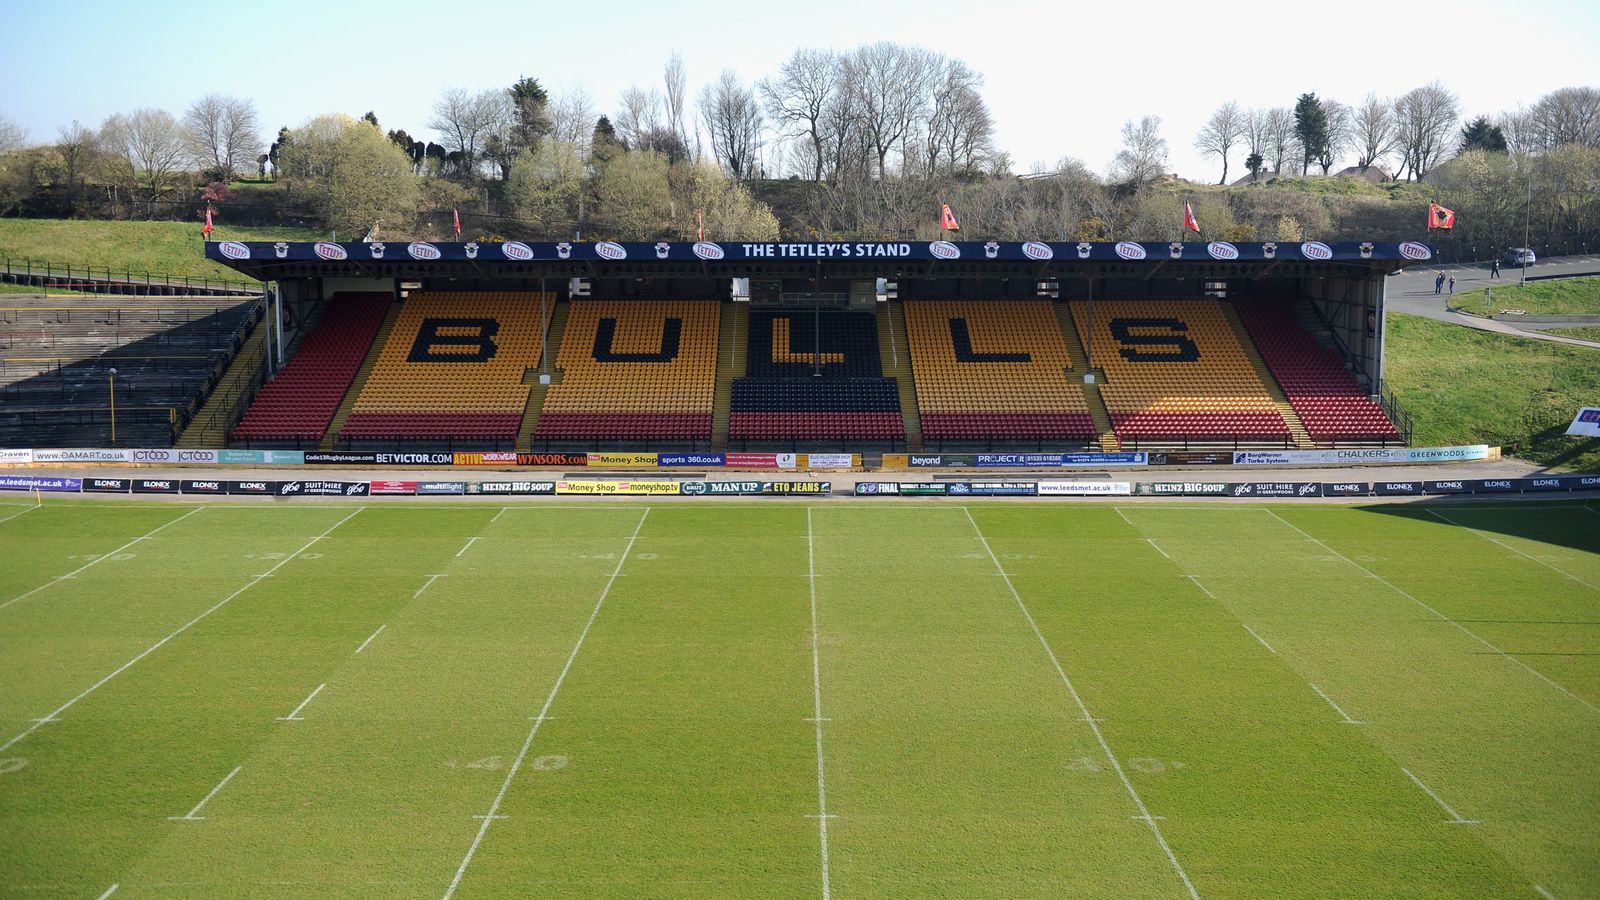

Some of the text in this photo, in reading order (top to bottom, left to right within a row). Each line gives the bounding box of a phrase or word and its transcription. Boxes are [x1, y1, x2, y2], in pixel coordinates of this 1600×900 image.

[743, 244, 910, 256] THE TETLEY'S STAND
[306, 454, 374, 463] Code13RugbyLeague.com
[1338, 450, 1389, 458] CHALKERS
[1410, 450, 1465, 458] GREENWOODS
[453, 453, 484, 465] ACTIVE
[518, 454, 587, 465] WYNSORS.COM
[600, 455, 657, 466] Money Shop
[662, 457, 686, 466] sports
[912, 456, 941, 466] beyond
[424, 483, 462, 491] multiflight
[512, 482, 530, 491] BIG
[530, 483, 554, 491] SOUP
[630, 483, 678, 492] moneyshop.tv
[711, 482, 758, 492] MAN UP
[774, 482, 819, 492] ETO JEANS
[878, 483, 898, 492] FINAL
[1184, 482, 1202, 492] BIG
[1202, 484, 1224, 492] SOUP
[1386, 483, 1412, 491] ELONEX
[1484, 480, 1510, 488] ELONEX
[1533, 479, 1560, 487] ELONEX
[568, 483, 616, 493] Money Shop
[1041, 484, 1110, 492] www.leedsmet.ac.uk
